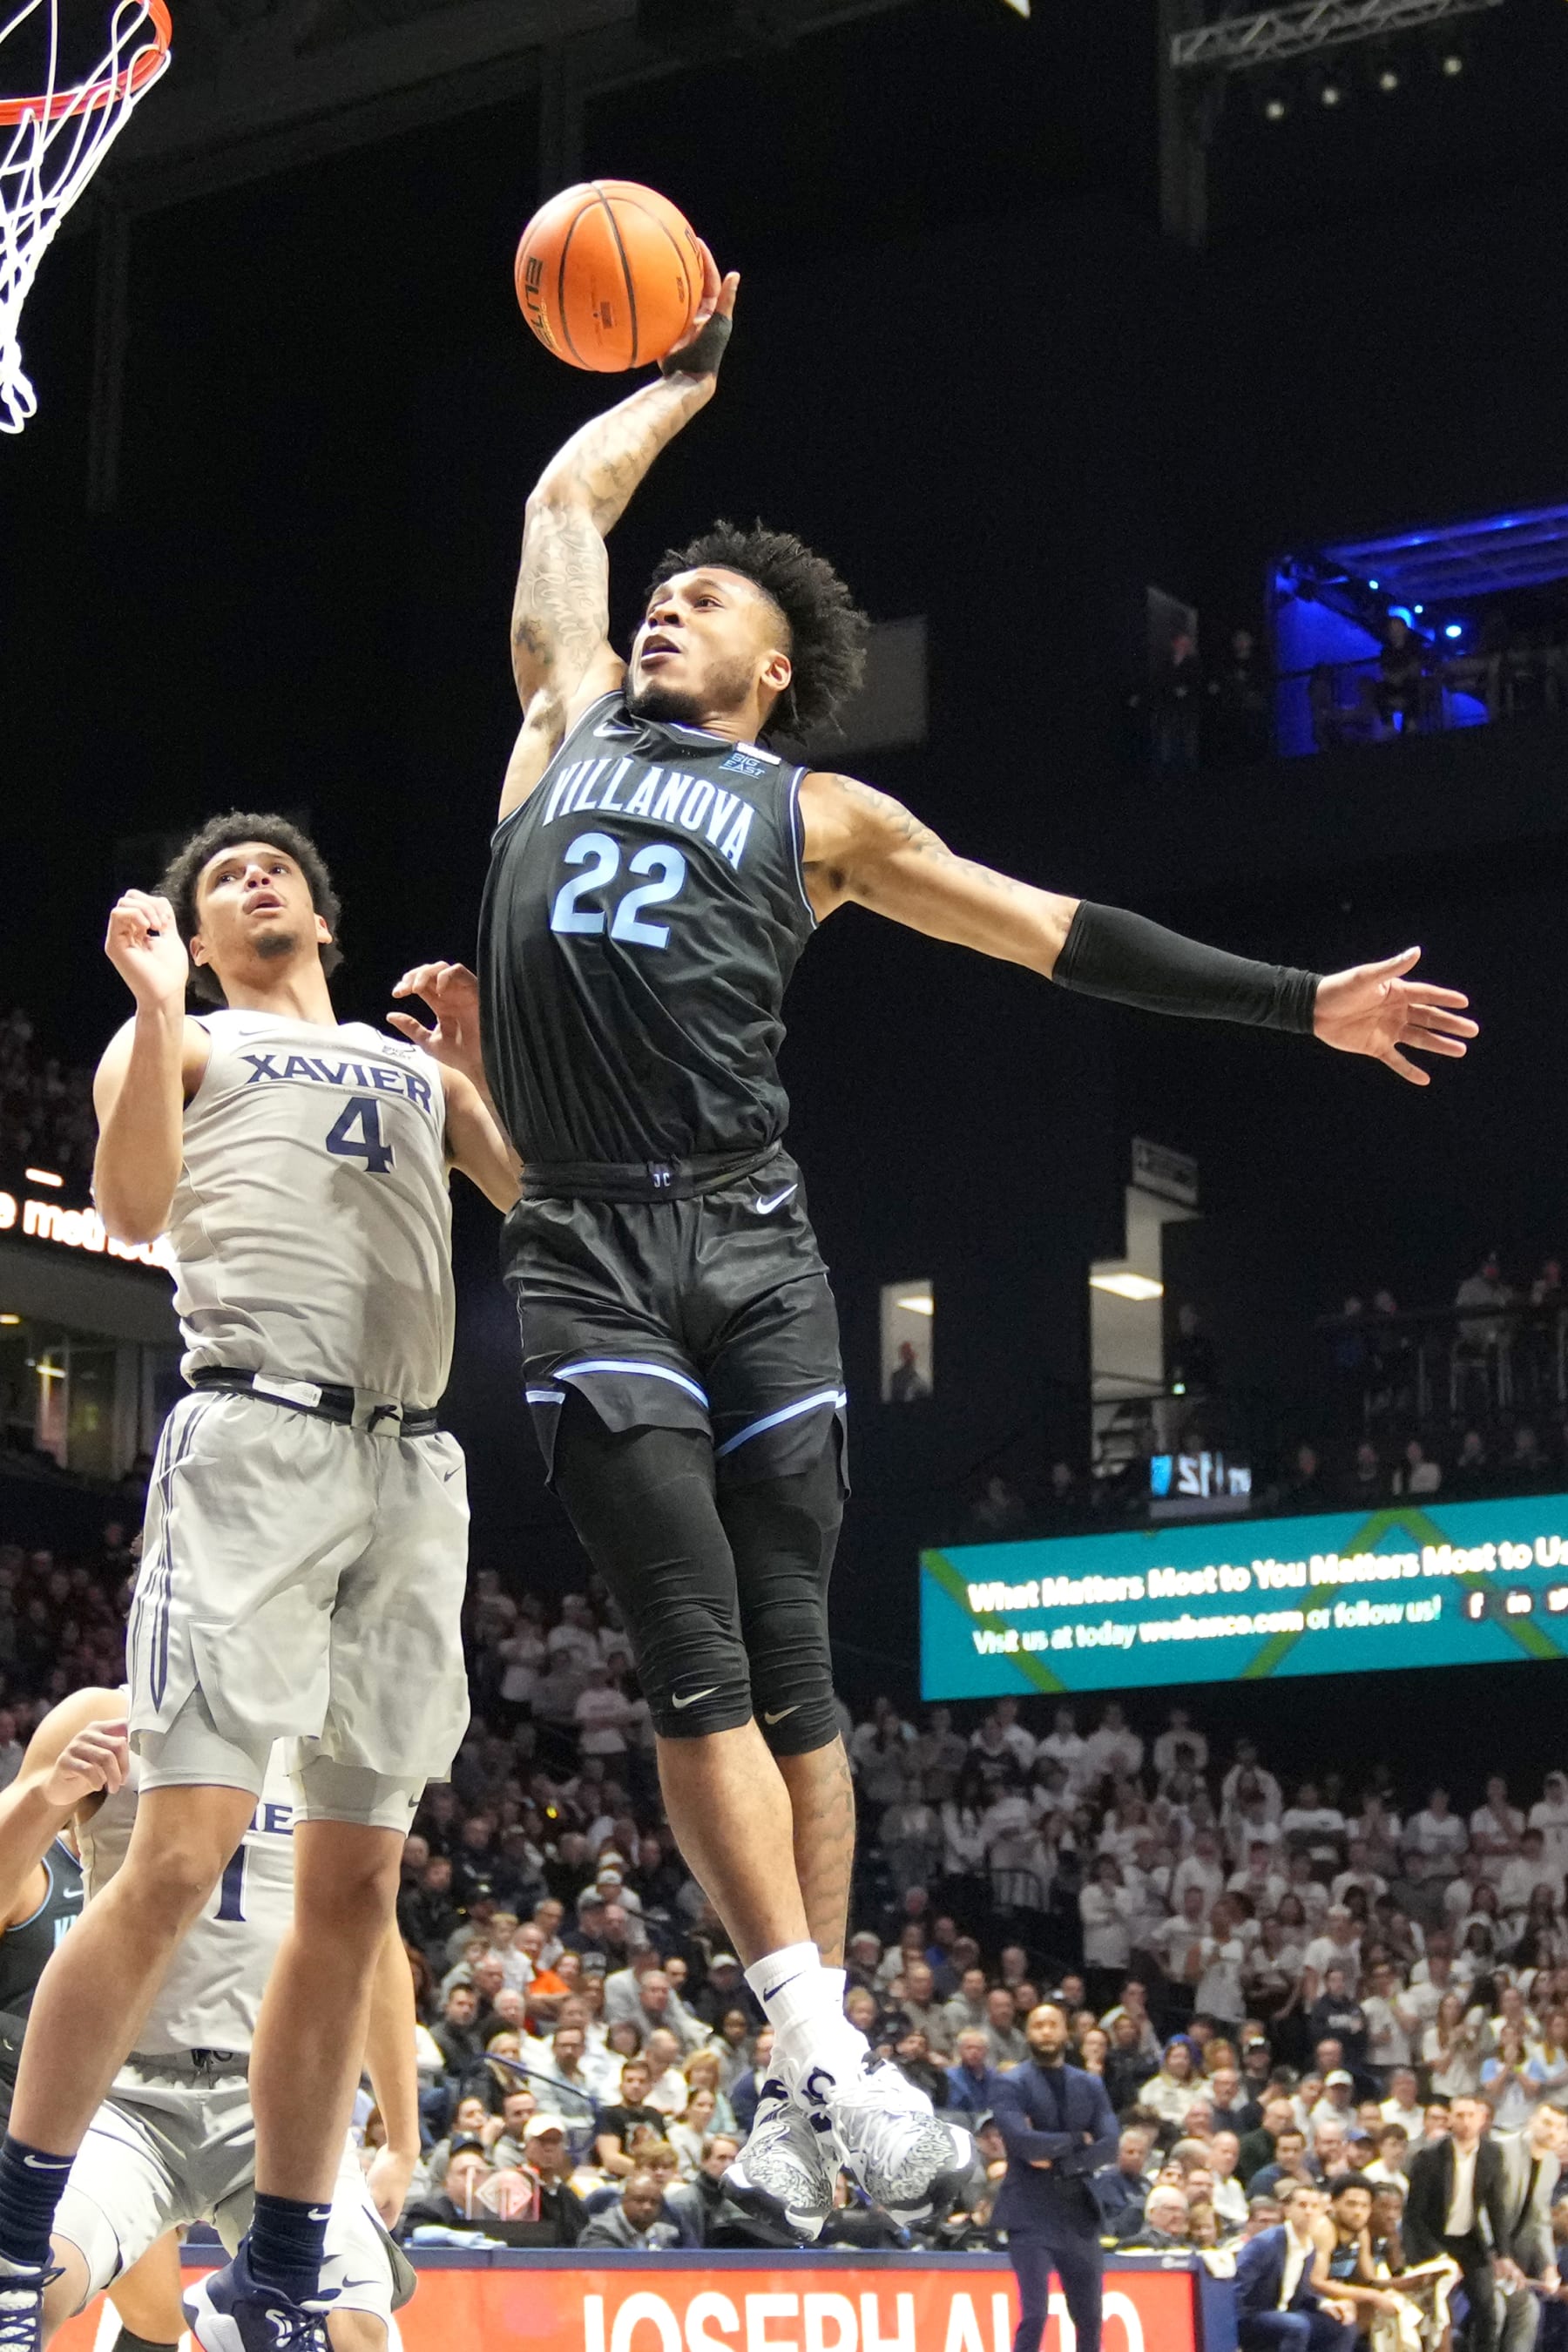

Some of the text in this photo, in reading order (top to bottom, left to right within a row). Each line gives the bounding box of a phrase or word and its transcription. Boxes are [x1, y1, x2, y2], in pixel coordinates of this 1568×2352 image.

[722, 760, 766, 776] EAST
[732, 752, 760, 767] BIG
[542, 756, 756, 871] VILLANOVA
[551, 831, 686, 950] 22
[237, 1054, 432, 1114] XAVIER
[325, 1096, 395, 1174] 4
[968, 1580, 1040, 1612] What
[1041, 1575, 1146, 1608] Matters
[1147, 1566, 1219, 1599] Most
[1219, 1564, 1251, 1592] to
[1252, 1558, 1308, 1590] You
[1308, 1552, 1421, 1586] Matters
[1422, 1543, 1497, 1577] Most
[1497, 1541, 1534, 1571] to
[972, 1629, 1018, 1654] Visit
[1022, 1631, 1049, 1652] us
[1051, 1625, 1073, 1650] at
[1076, 1620, 1137, 1649] today
[1306, 1608, 1331, 1630] or
[1335, 1600, 1404, 1628] follow
[1405, 1593, 1442, 1623] us!
